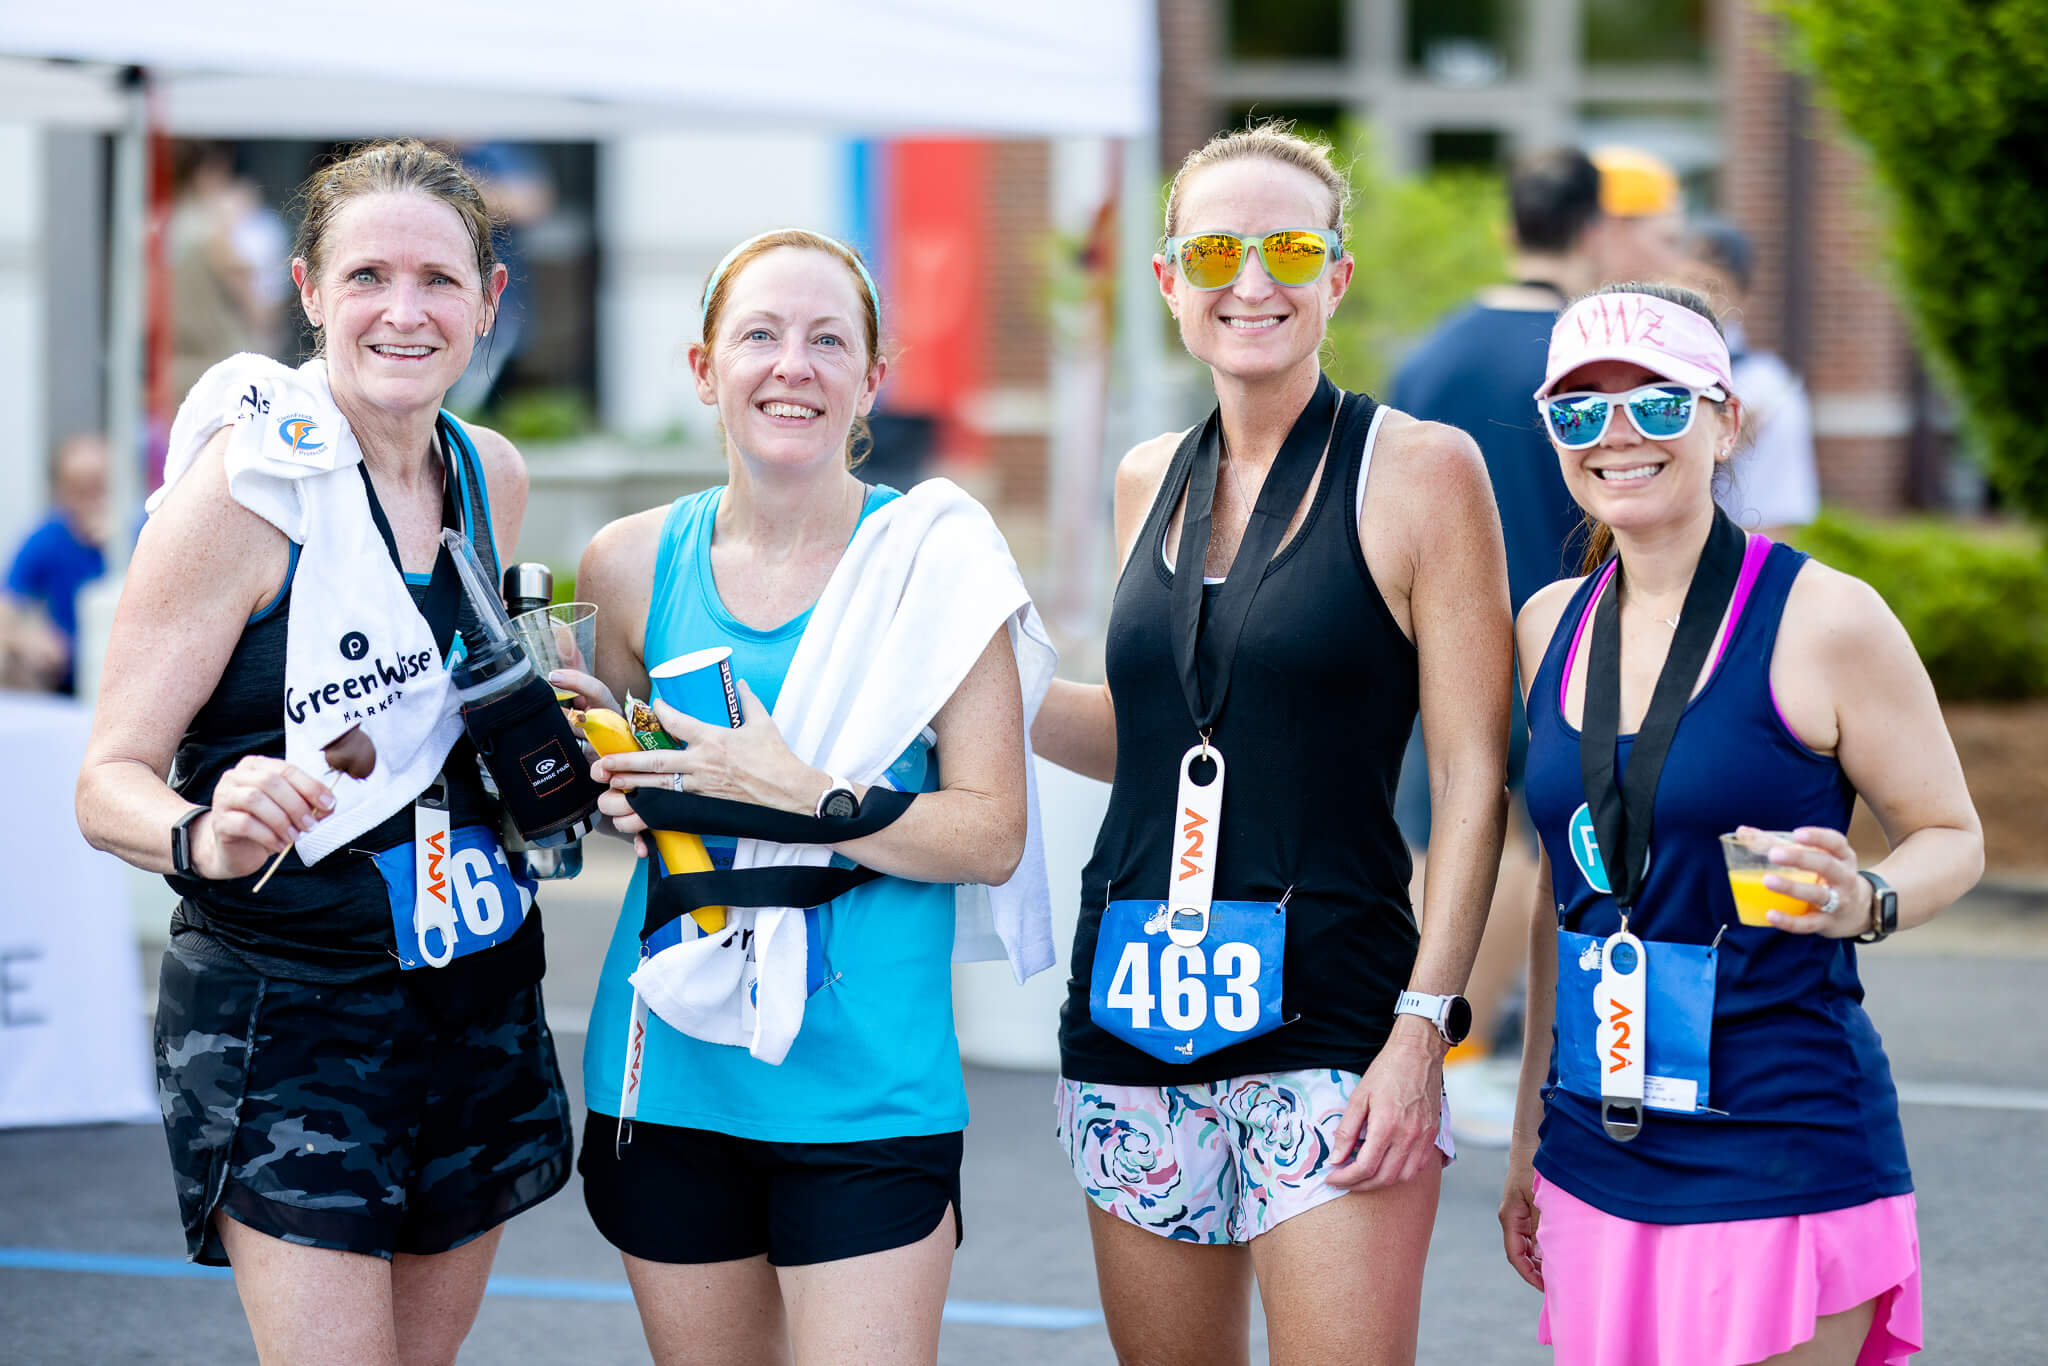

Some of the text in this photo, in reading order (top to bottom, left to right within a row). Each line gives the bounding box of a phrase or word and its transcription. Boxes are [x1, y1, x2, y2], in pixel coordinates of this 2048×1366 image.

[286, 651, 432, 724] GreenWise
[343, 691, 403, 723] MARKET
[720, 661, 741, 729] WERADE
[1107, 941, 1261, 1032] 463
